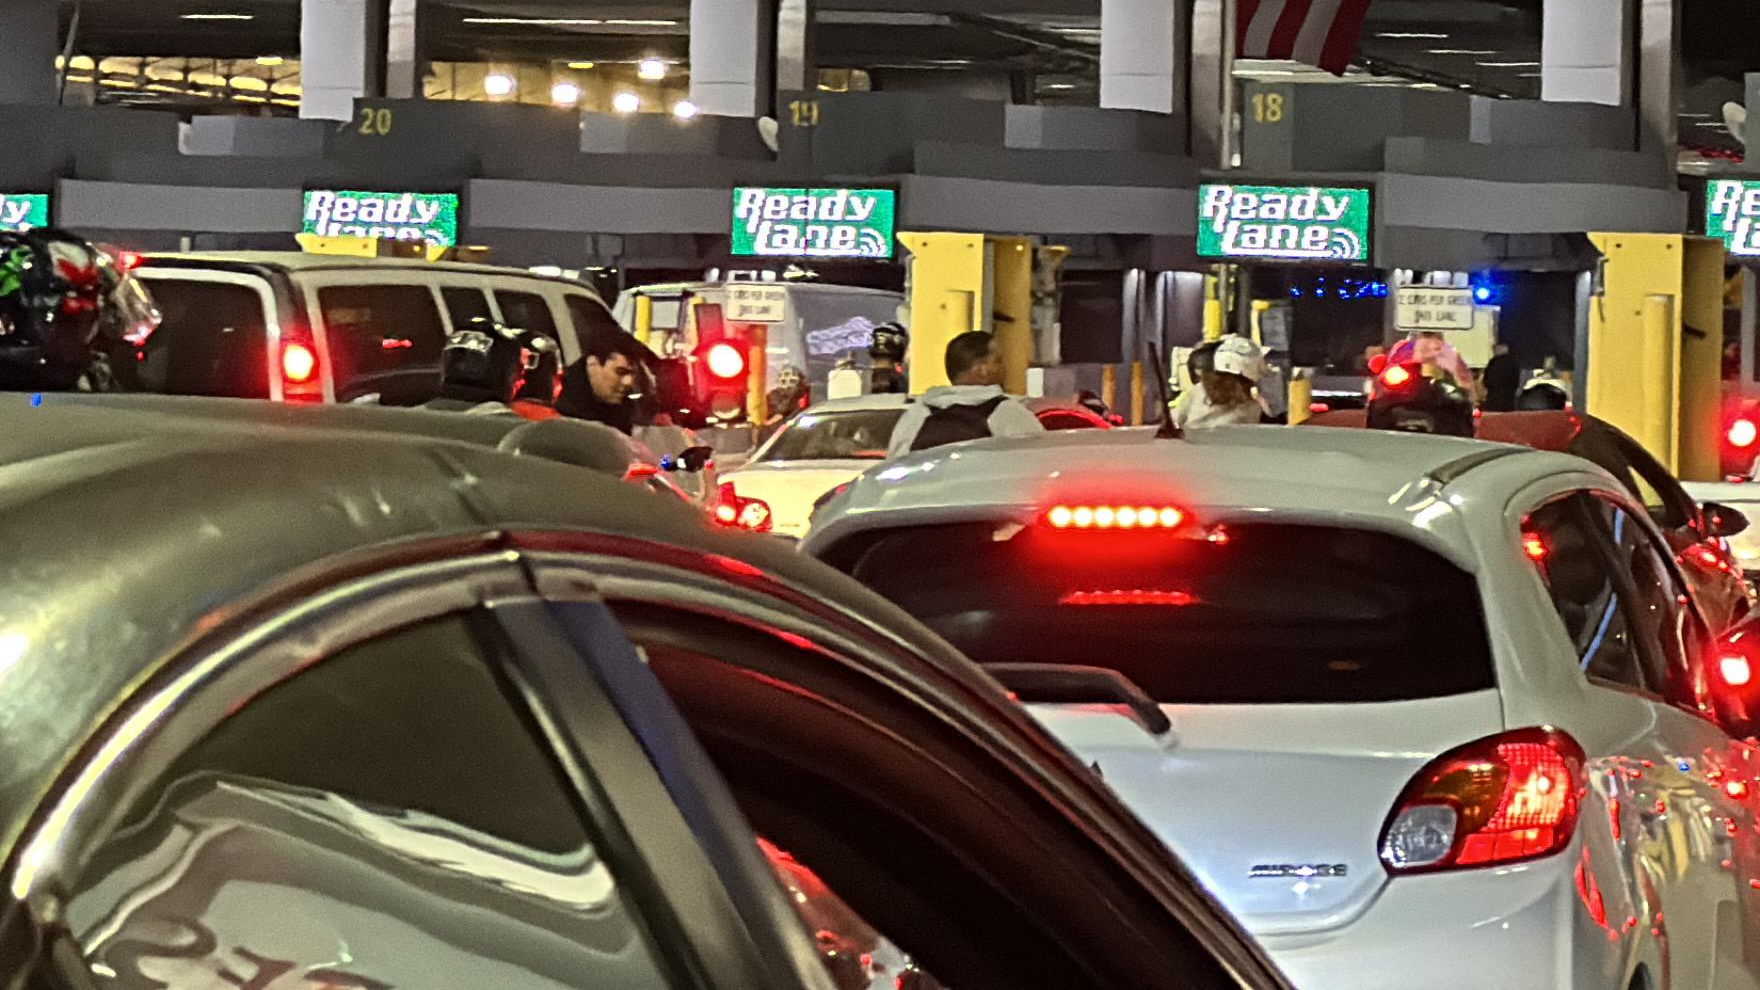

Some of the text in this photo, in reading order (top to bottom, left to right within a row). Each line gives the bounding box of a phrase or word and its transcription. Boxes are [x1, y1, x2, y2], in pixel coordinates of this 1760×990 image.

[357, 107, 392, 135] 20
[1252, 93, 1284, 123] 18
[305, 190, 439, 236] Ready
[736, 188, 876, 234] Ready
[1203, 185, 1350, 234] Ready
[754, 220, 857, 257] Lane
[1221, 220, 1335, 258] Lane
